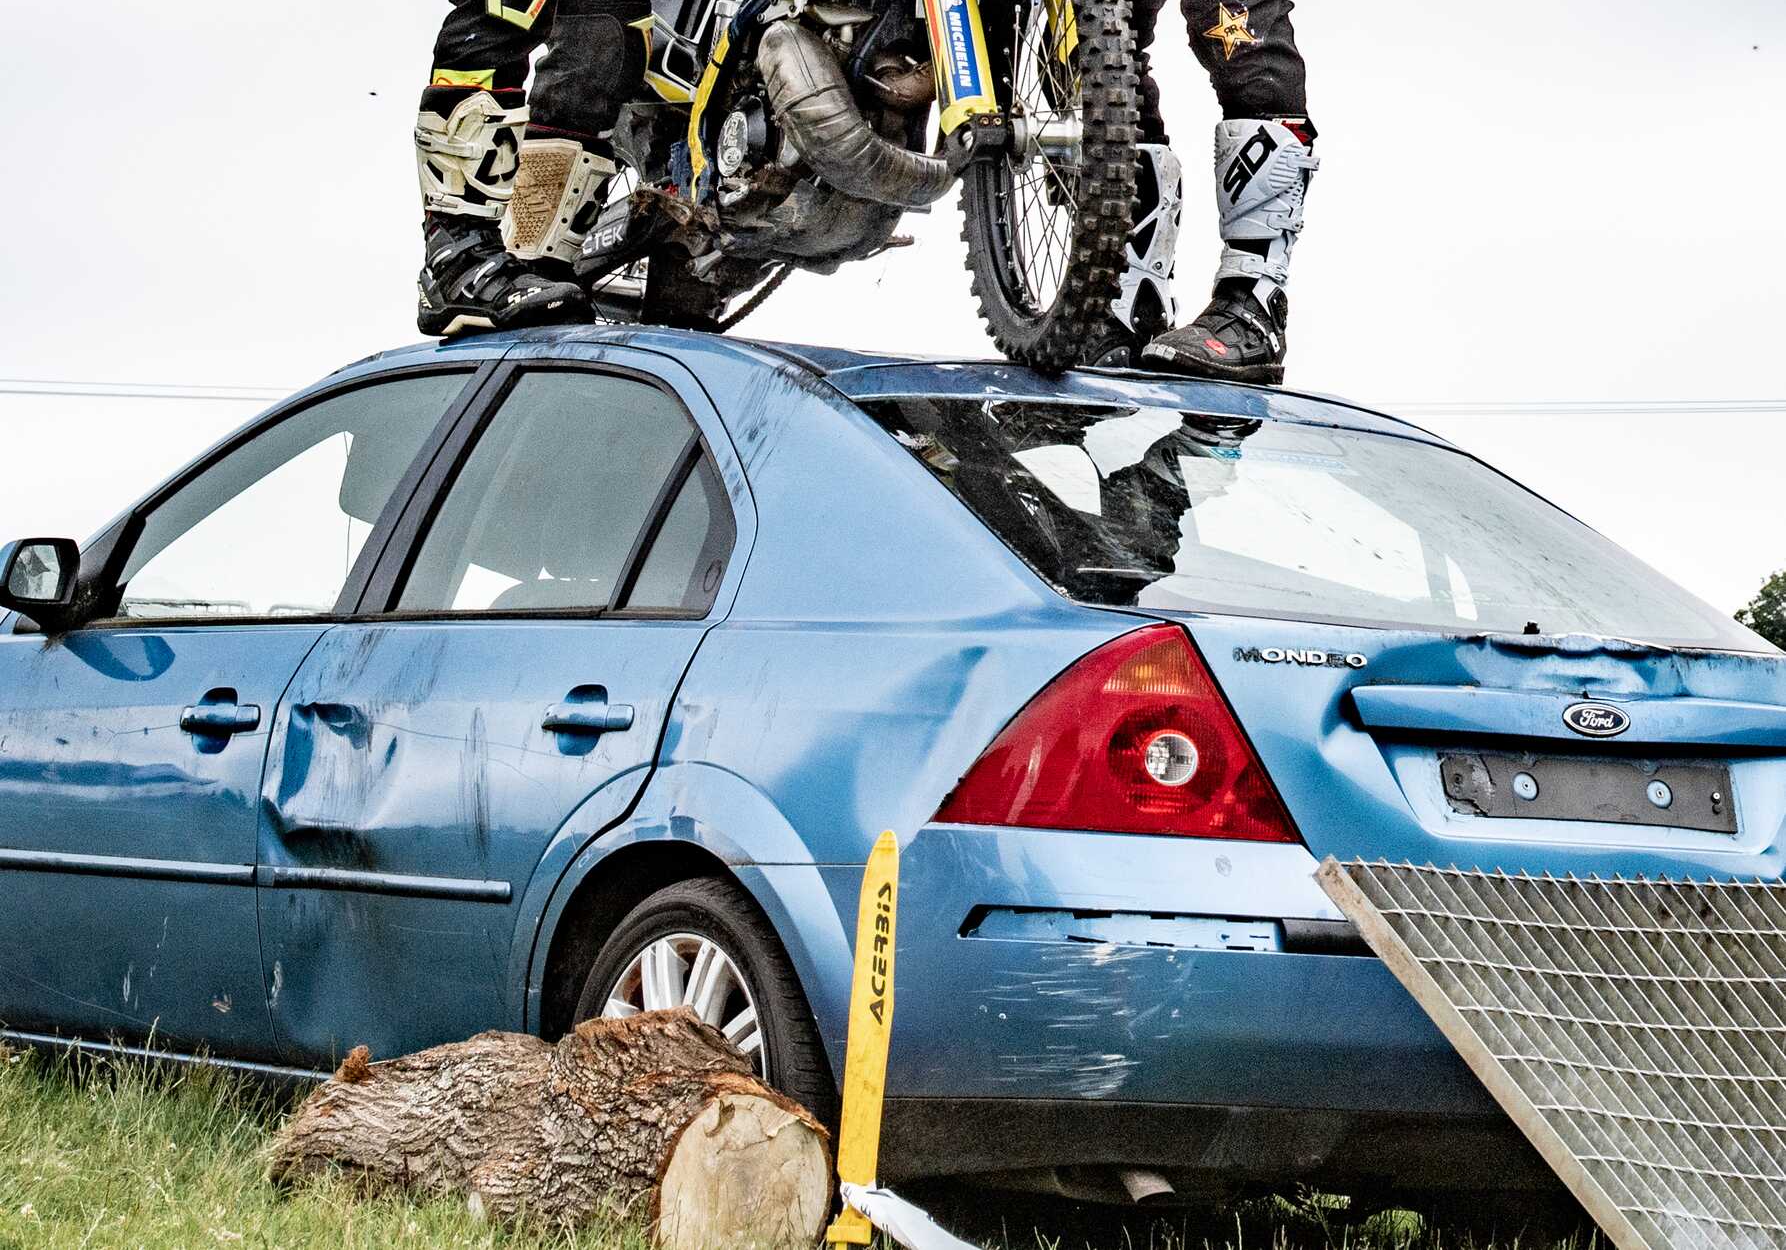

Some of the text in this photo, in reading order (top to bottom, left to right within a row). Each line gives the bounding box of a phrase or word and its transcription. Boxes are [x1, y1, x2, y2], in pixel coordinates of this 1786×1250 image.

[949, 11, 973, 88] MICHELIN
[1233, 648, 1368, 669] MONDEO
[1580, 709, 1614, 728] Ford
[869, 881, 893, 1026] ACERBIS
